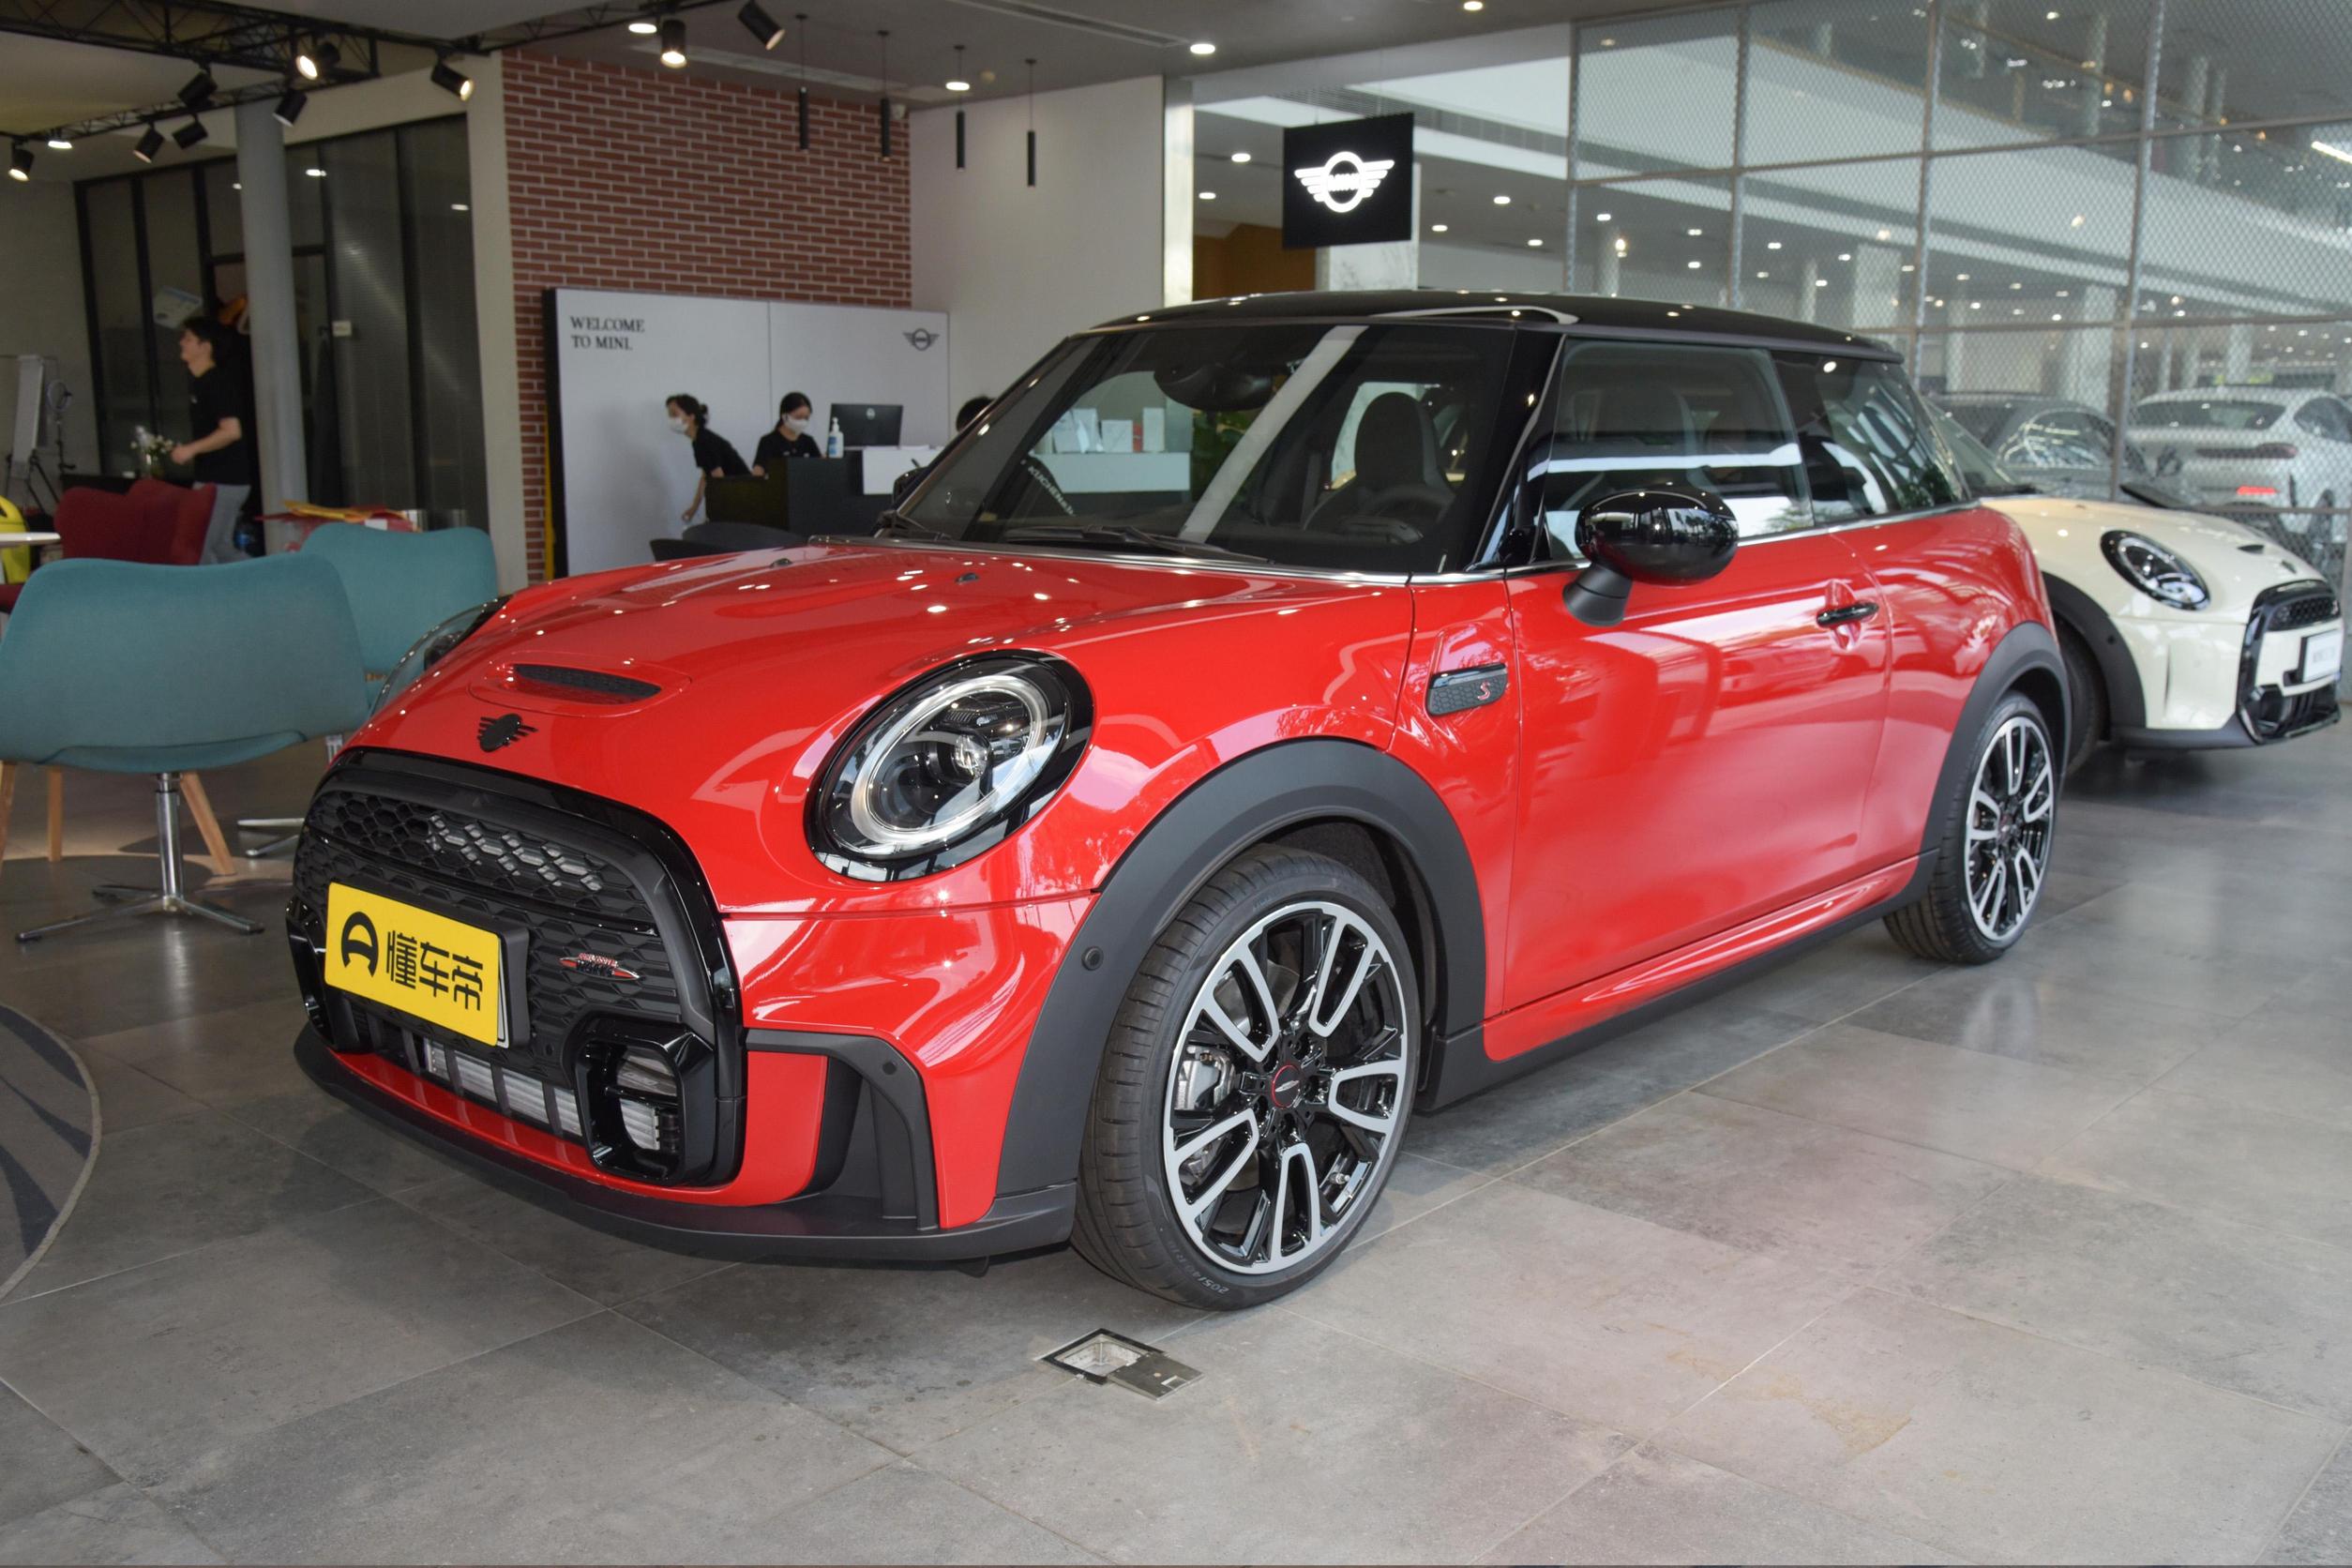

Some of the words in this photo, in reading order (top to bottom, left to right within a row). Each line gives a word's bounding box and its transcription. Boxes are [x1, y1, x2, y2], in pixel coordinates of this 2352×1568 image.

[569, 315, 645, 333] WELCOME
[570, 335, 591, 349] TO
[385, 929, 484, 1011] 懂车帝
